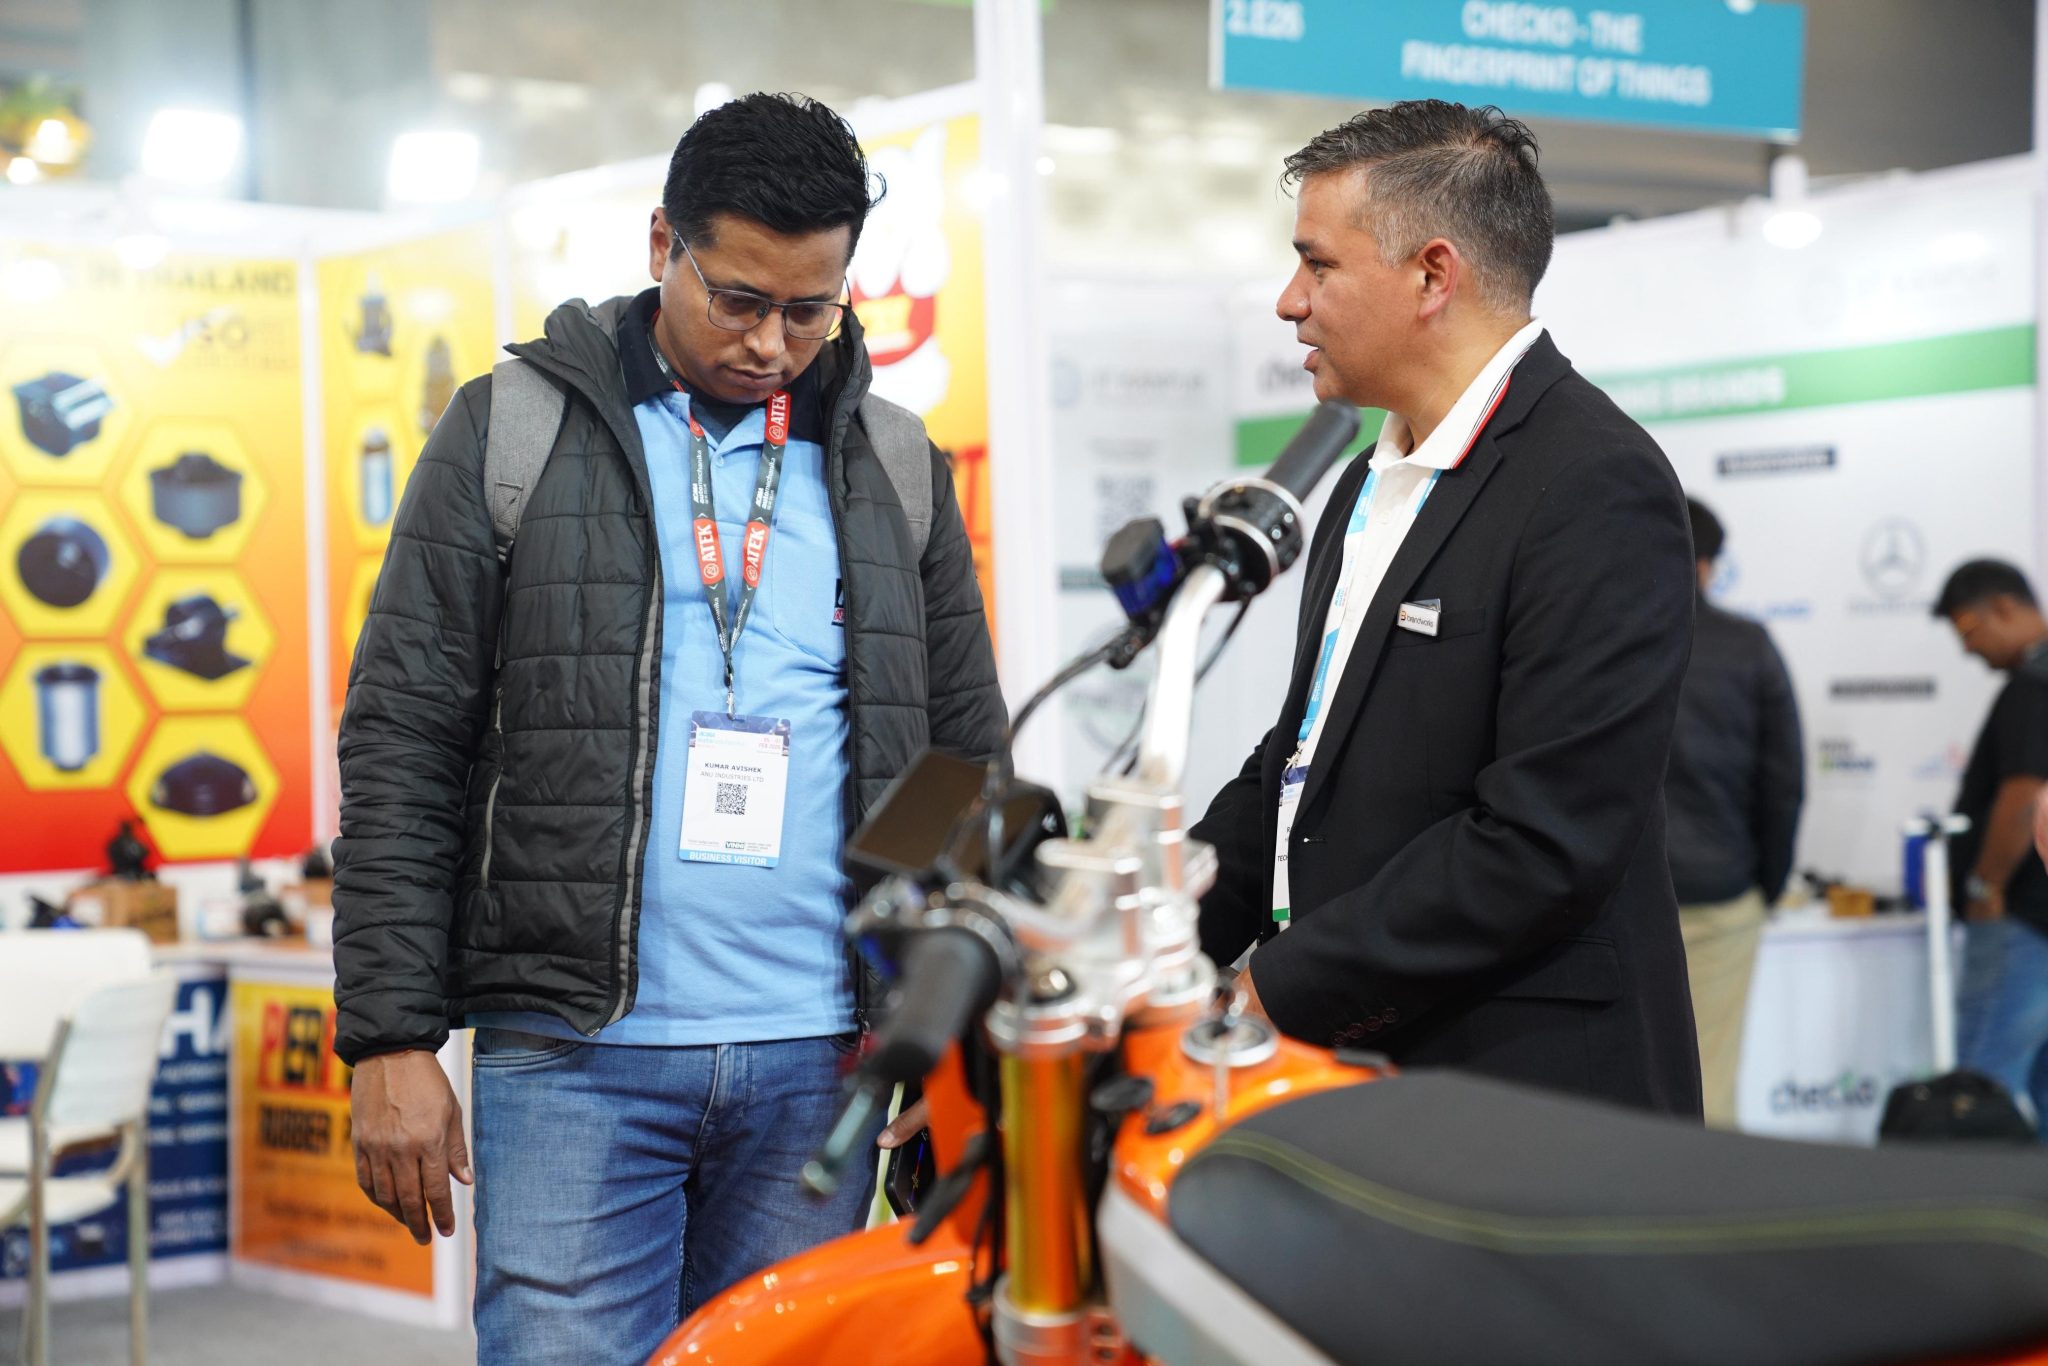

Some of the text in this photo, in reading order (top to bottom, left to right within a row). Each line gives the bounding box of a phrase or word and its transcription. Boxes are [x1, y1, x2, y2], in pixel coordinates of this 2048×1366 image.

[1463, 0, 1577, 48] CHECKO
[1590, 10, 1642, 54] THE
[1402, 40, 1711, 105] FINGERPRINT OF THINGS
[771, 394, 786, 426] ATEK
[762, 457, 775, 509] automechanika
[697, 524, 717, 562] ATEK
[747, 528, 765, 567] ATEK
[704, 762, 762, 773] KUMAR AVISHEK
[715, 773, 751, 781] INDUSTRIES
[689, 851, 768, 866] BUSINESS VISITOR
